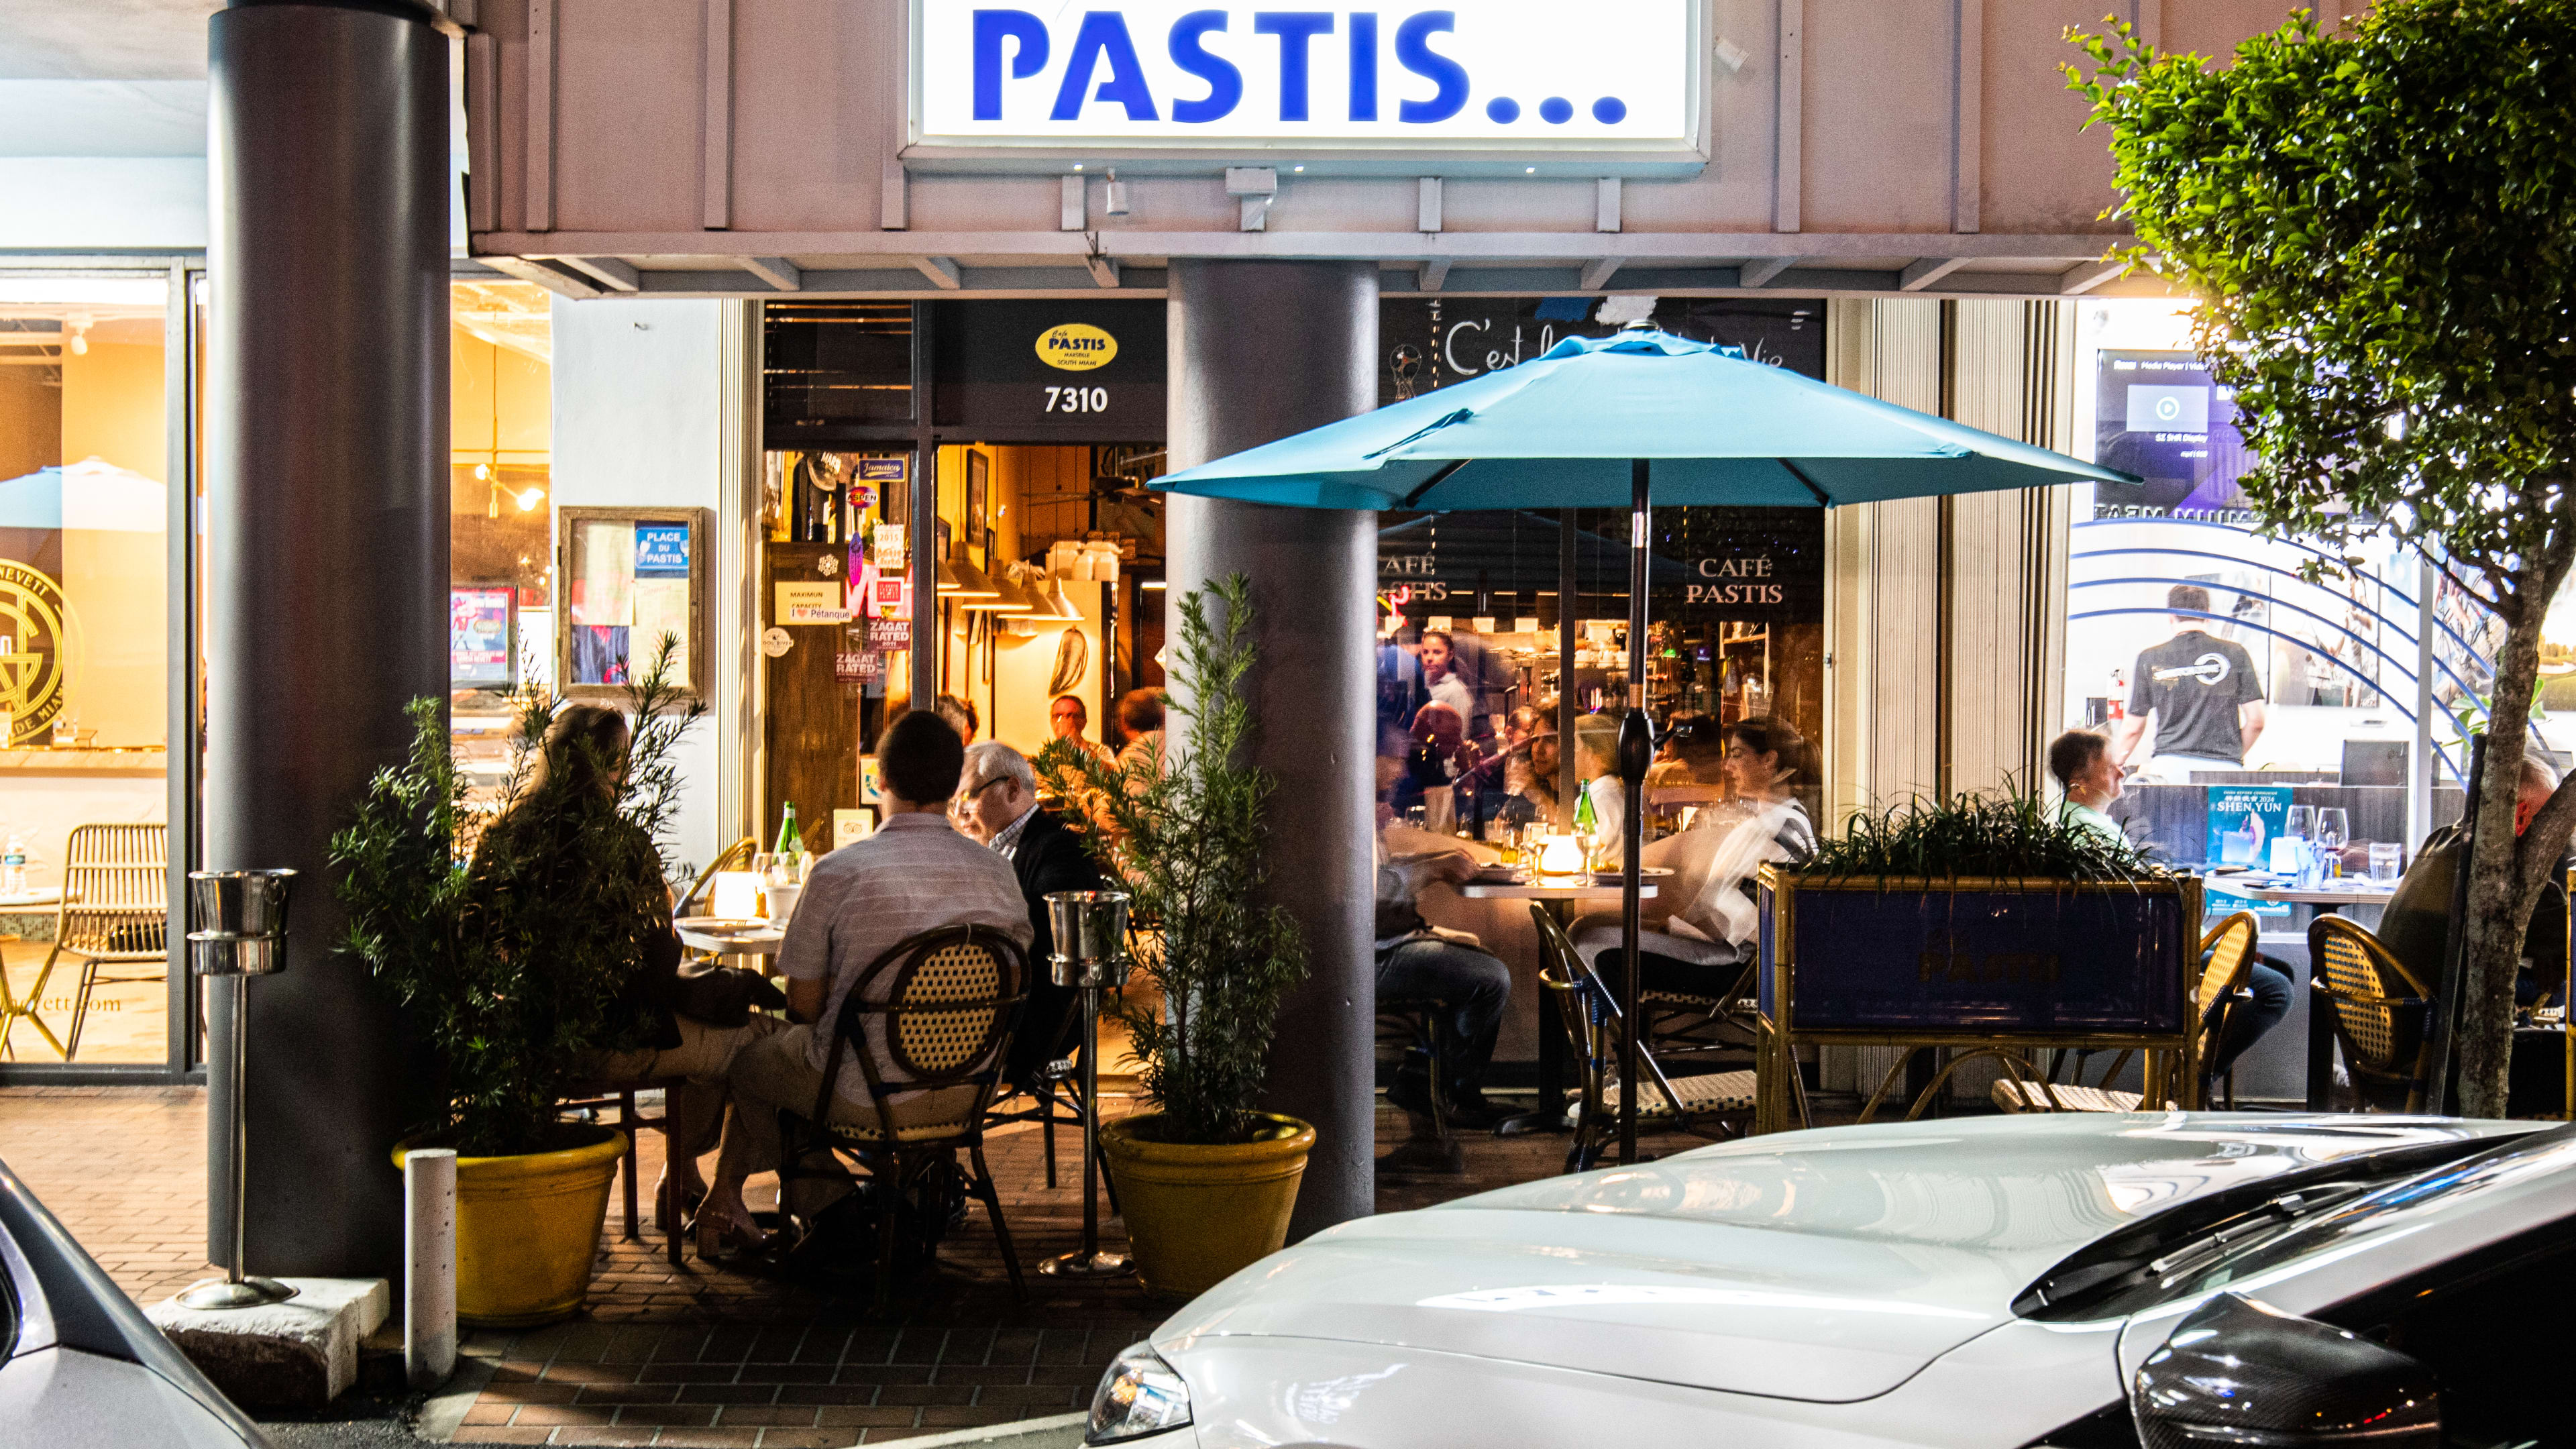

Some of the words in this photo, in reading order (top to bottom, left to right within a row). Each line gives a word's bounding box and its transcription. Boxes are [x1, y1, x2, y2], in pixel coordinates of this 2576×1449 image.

[1049, 338, 1106, 350] PASTIS
[1045, 386, 1108, 413] 7310
[864, 463, 900, 474] Jamaica
[647, 532, 681, 542] PLACE
[879, 533, 898, 541] 2015
[658, 544, 669, 552] DU
[647, 554, 682, 564] PASTIS
[1383, 551, 1435, 574] AFÉ
[1699, 554, 1771, 578] CAFÉ
[1686, 585, 1783, 604] PASTIS
[792, 609, 795, 617] I
[810, 608, 850, 620] Pétanque
[869, 622, 910, 631] ZAGAT
[869, 632, 910, 641] RATED
[836, 653, 875, 663] ZAGAT
[836, 663, 875, 674] RATED
[15, 718, 34, 735] DE
[2217, 801, 2252, 812] SHEN
[2255, 802, 2282, 812] YUN
